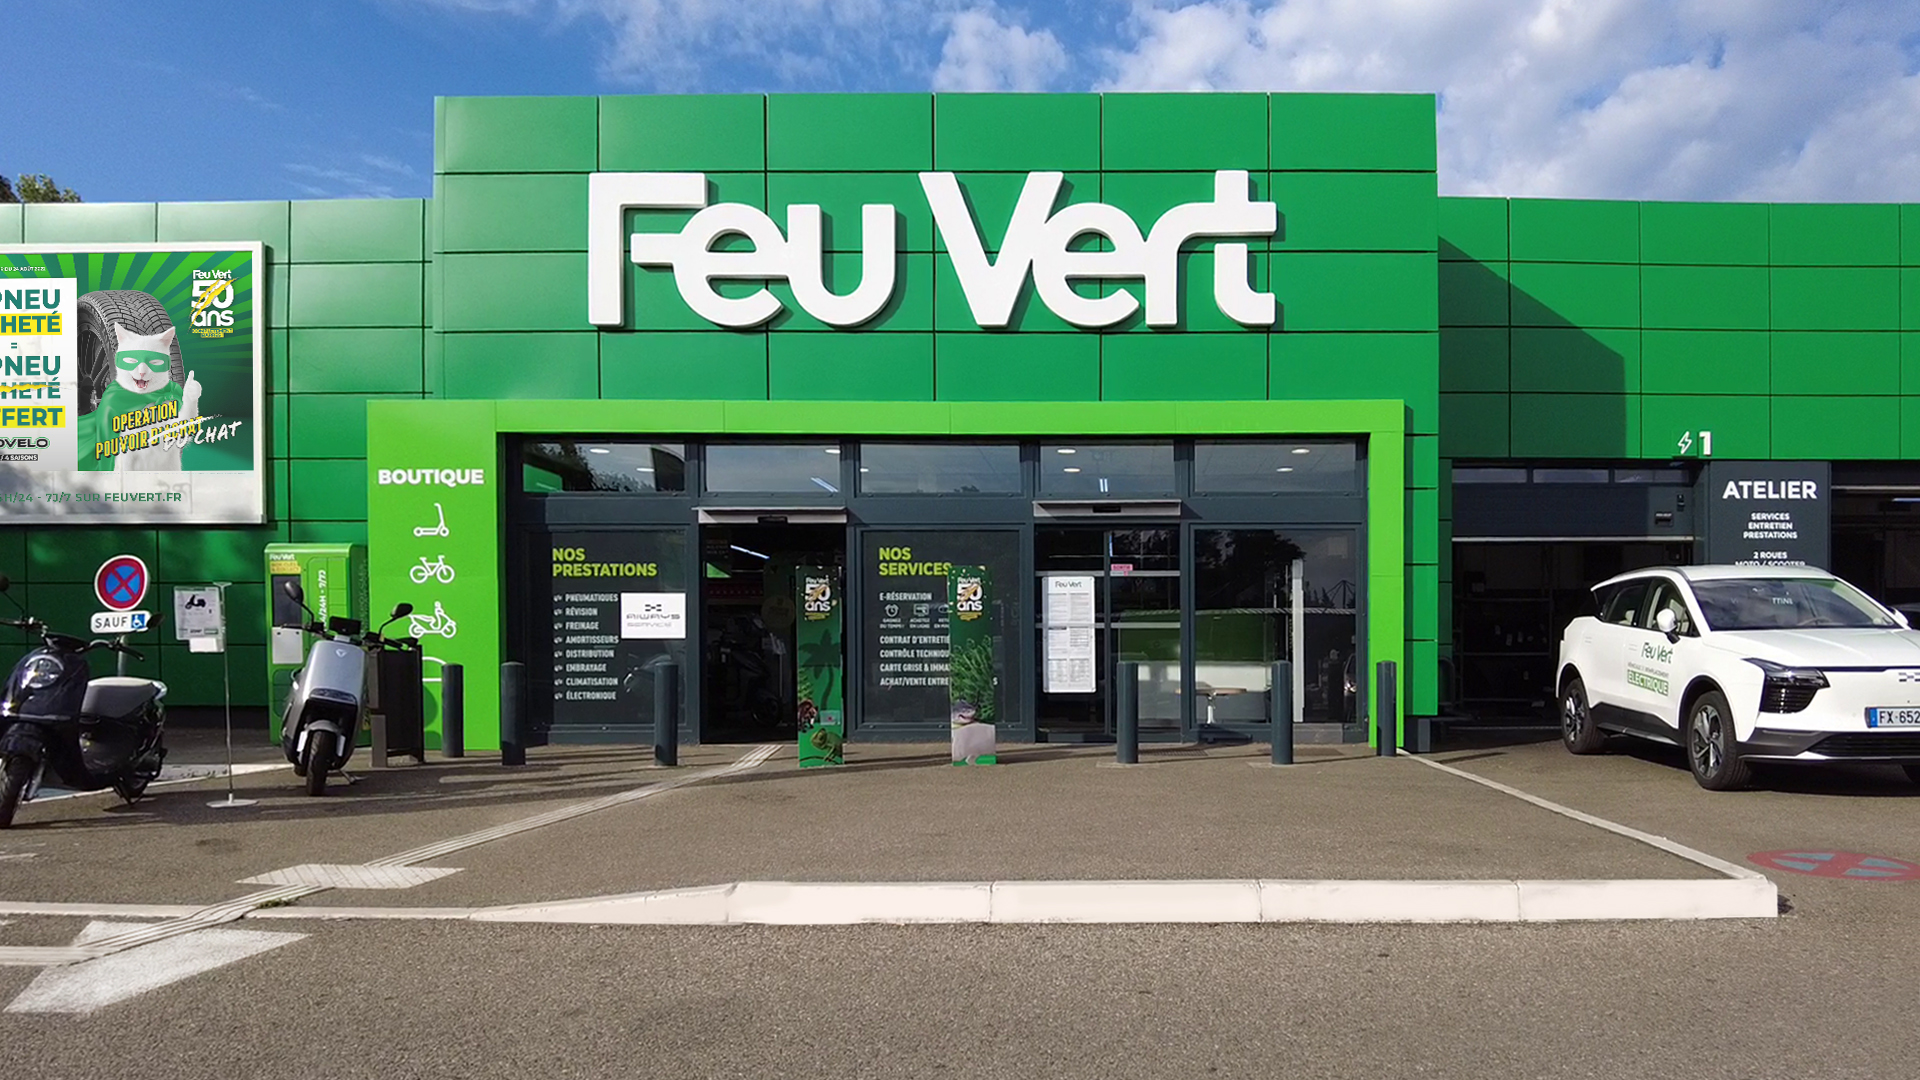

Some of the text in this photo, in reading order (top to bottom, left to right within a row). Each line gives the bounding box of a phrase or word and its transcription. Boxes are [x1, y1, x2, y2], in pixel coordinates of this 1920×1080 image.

[588, 169, 1277, 328] Feu Vert
[192, 269, 232, 280] Feu Vert
[0, 289, 61, 310] NEU
[191, 279, 235, 309] 50
[0, 310, 61, 333] HETÉ
[190, 309, 235, 327] ans
[0, 355, 61, 376] NEU
[0, 407, 63, 427] FERT
[112, 400, 179, 433] OPERATION
[193, 420, 242, 444] CHAT
[95, 430, 149, 461] POUVOIR
[1698, 430, 1713, 456] 1
[377, 468, 485, 488] BOUTIQUE
[1722, 480, 1817, 499] ATELIER
[0, 492, 34, 503] H/24
[75, 492, 100, 502] SUR
[104, 491, 182, 503] FEUVERT.FR
[1750, 512, 1791, 521] SERVICES
[1747, 522, 1793, 530] ENTRETIEN
[1742, 531, 1798, 540] PRESTATIONS
[552, 548, 586, 561] NOS
[878, 547, 912, 561] NOS
[1753, 551, 1788, 559] 2 ROUES
[552, 563, 657, 577] PRESTATIONS
[878, 562, 951, 576] SERVICES
[564, 593, 619, 602] PNEUMATIQUES
[879, 592, 933, 601] E-RÉSERVATION
[564, 606, 598, 616] RÉVISION
[804, 600, 831, 612] ans
[956, 600, 983, 612] ans
[94, 616, 128, 628] SAUF
[564, 621, 599, 630] FREINAGE
[564, 635, 619, 644] AMORTISSEURS
[880, 636, 911, 644] CONTRAT
[565, 649, 615, 658] DISTRIBUTION
[880, 648, 950, 658] CONTRÔLE TECHNIQU
[1641, 642, 1673, 664] Feu Vert
[565, 663, 607, 672] EMBRAYAGE
[879, 663, 902, 672] CARTE
[902, 663, 923, 672] GRISE
[565, 677, 619, 686] CLIMATISATION
[879, 677, 927, 686] ACHAT/VENTE
[565, 690, 617, 700] ÉLECTRONIQUE
